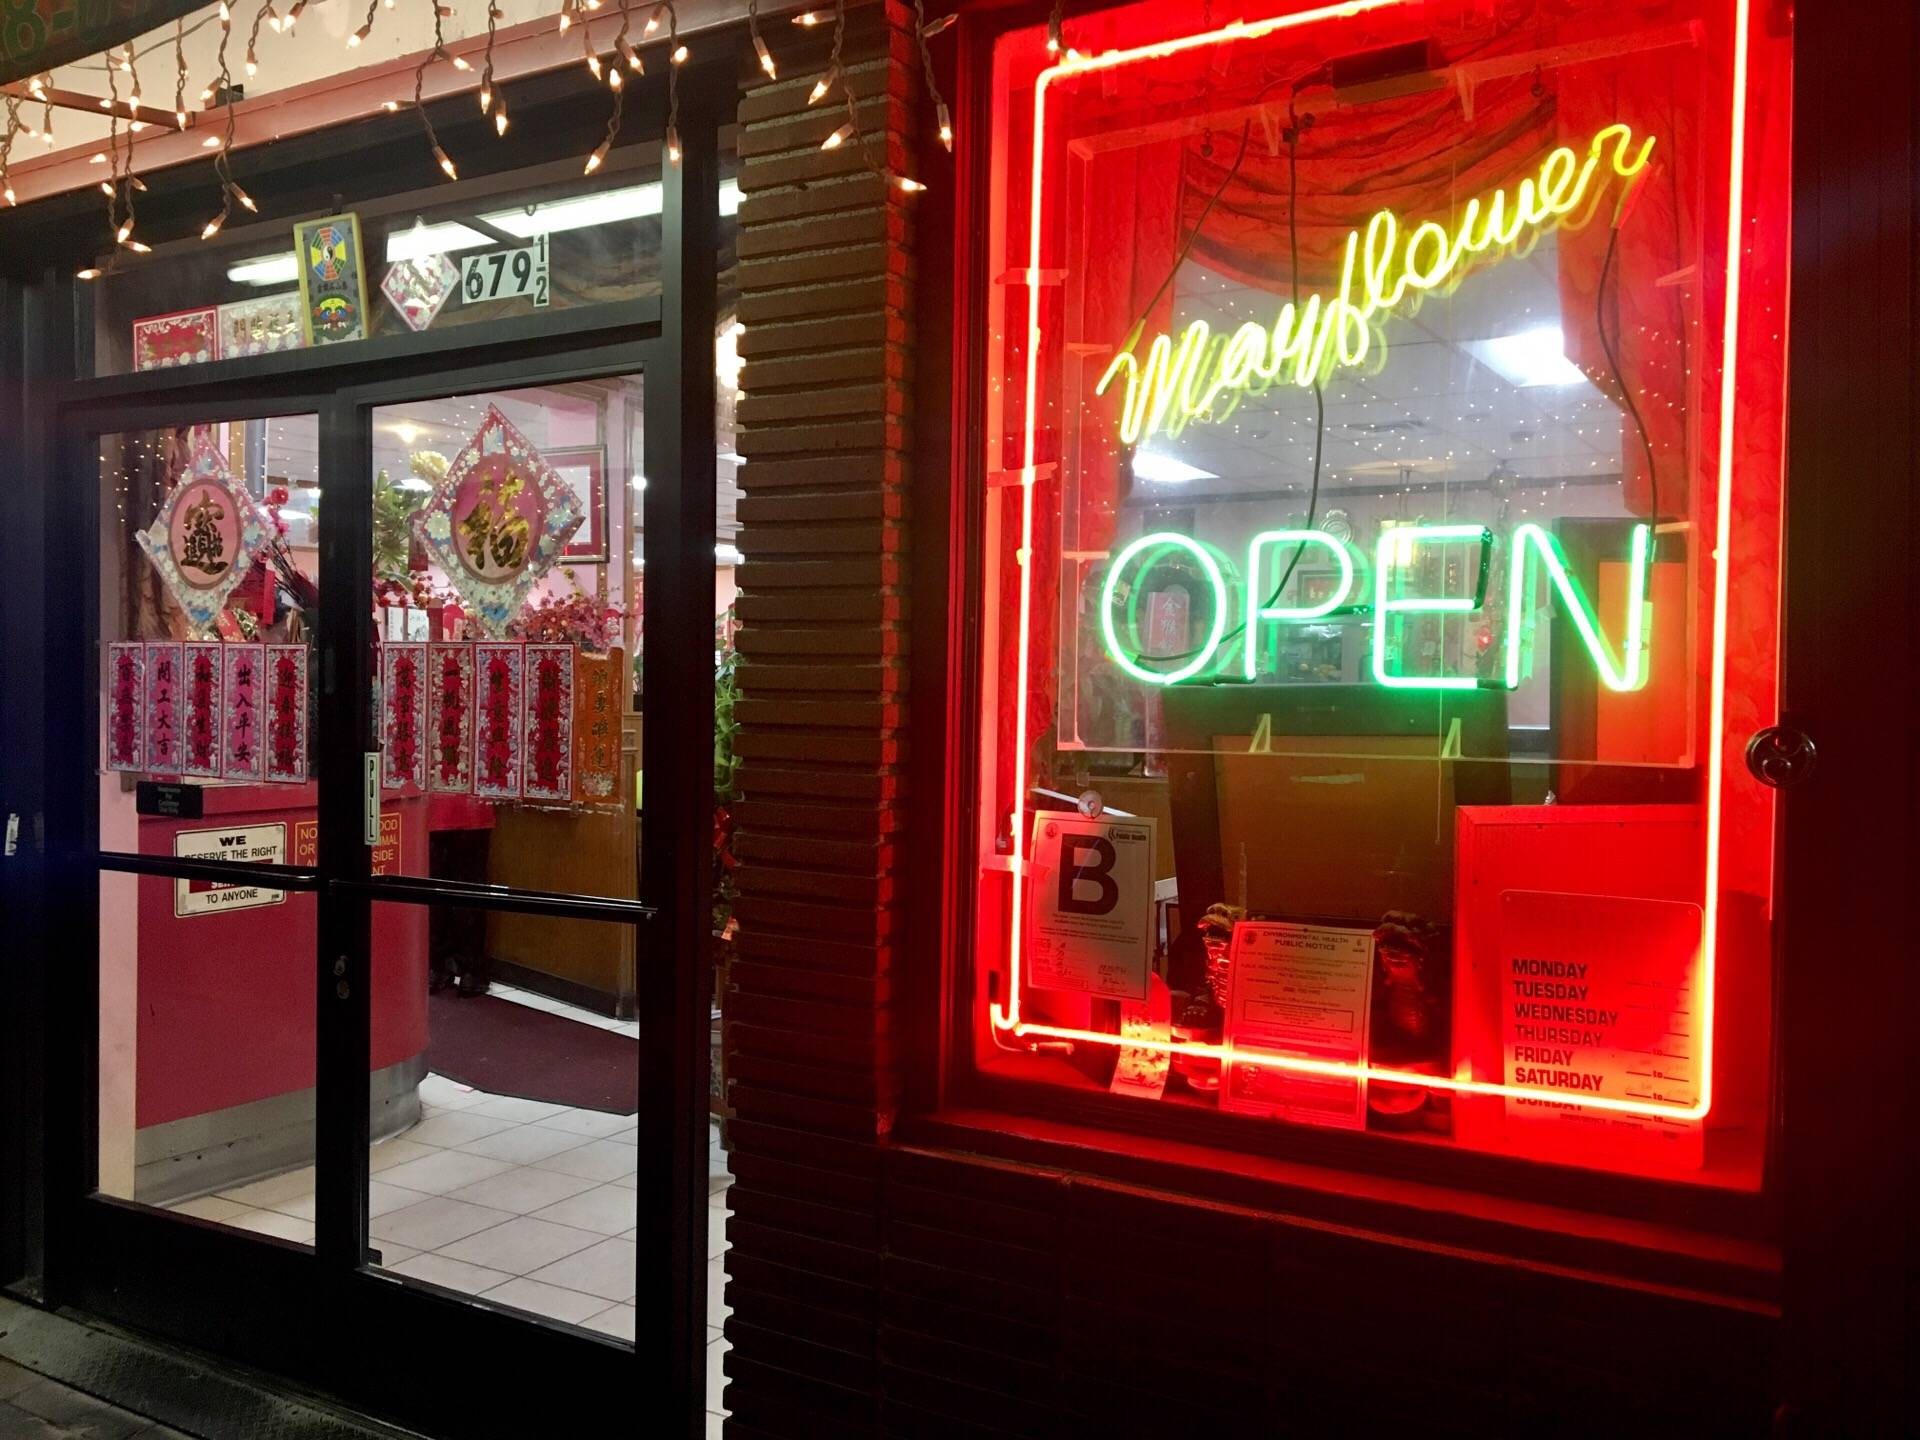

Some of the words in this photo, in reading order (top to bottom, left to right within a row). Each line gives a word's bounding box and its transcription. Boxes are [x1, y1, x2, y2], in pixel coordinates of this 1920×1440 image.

[465, 250, 531, 300] 679
[1096, 124, 1656, 445] Mayflower
[1101, 523, 1652, 692] OPEN
[157, 660, 172, 756] 開工大吉
[234, 663, 253, 763] 出入平安
[219, 835, 247, 847] WE
[300, 827, 318, 839] NO
[230, 848, 249, 860] THE
[251, 845, 277, 857] RIGHT
[299, 843, 316, 855] OR
[1058, 833, 1119, 916] B
[206, 893, 219, 904] TO
[222, 888, 258, 902] ANYONE
[1262, 930, 1320, 941] ENVIRONMENTAL
[1322, 935, 1349, 944] HEALTH
[1274, 939, 1304, 948] PUBLIC
[1305, 942, 1336, 951] NOTICE
[1512, 958, 1588, 979] MONDAY
[1512, 980, 1589, 1000] TUESDAY
[1514, 1003, 1619, 1026] WEDNESDAY
[1514, 1024, 1604, 1048] THURSDAY
[1514, 1046, 1574, 1066] FRIDAY
[1653, 1070, 1663, 1079] to
[1515, 1067, 1604, 1092] SATURDAY
[1653, 1092, 1663, 1101] to
[1653, 1115, 1663, 1123] to
